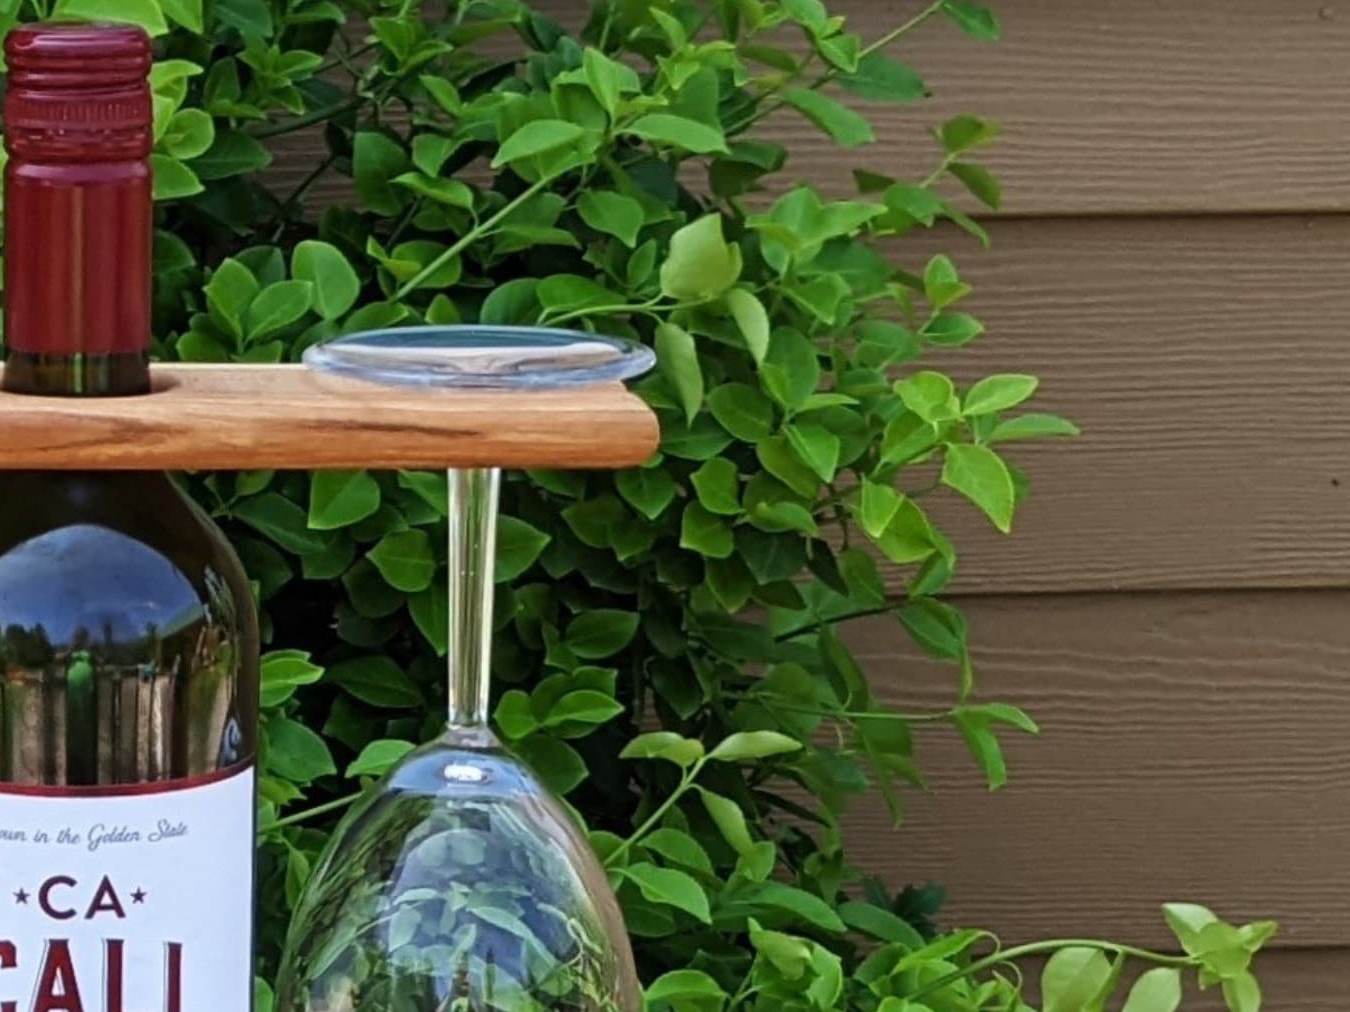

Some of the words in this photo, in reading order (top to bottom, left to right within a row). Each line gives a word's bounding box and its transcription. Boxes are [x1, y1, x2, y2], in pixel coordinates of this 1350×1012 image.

[33, 829, 50, 844] in
[56, 827, 81, 844] the
[87, 823, 141, 851] Golden
[147, 818, 189, 842] State
[37, 874, 126, 920] CA
